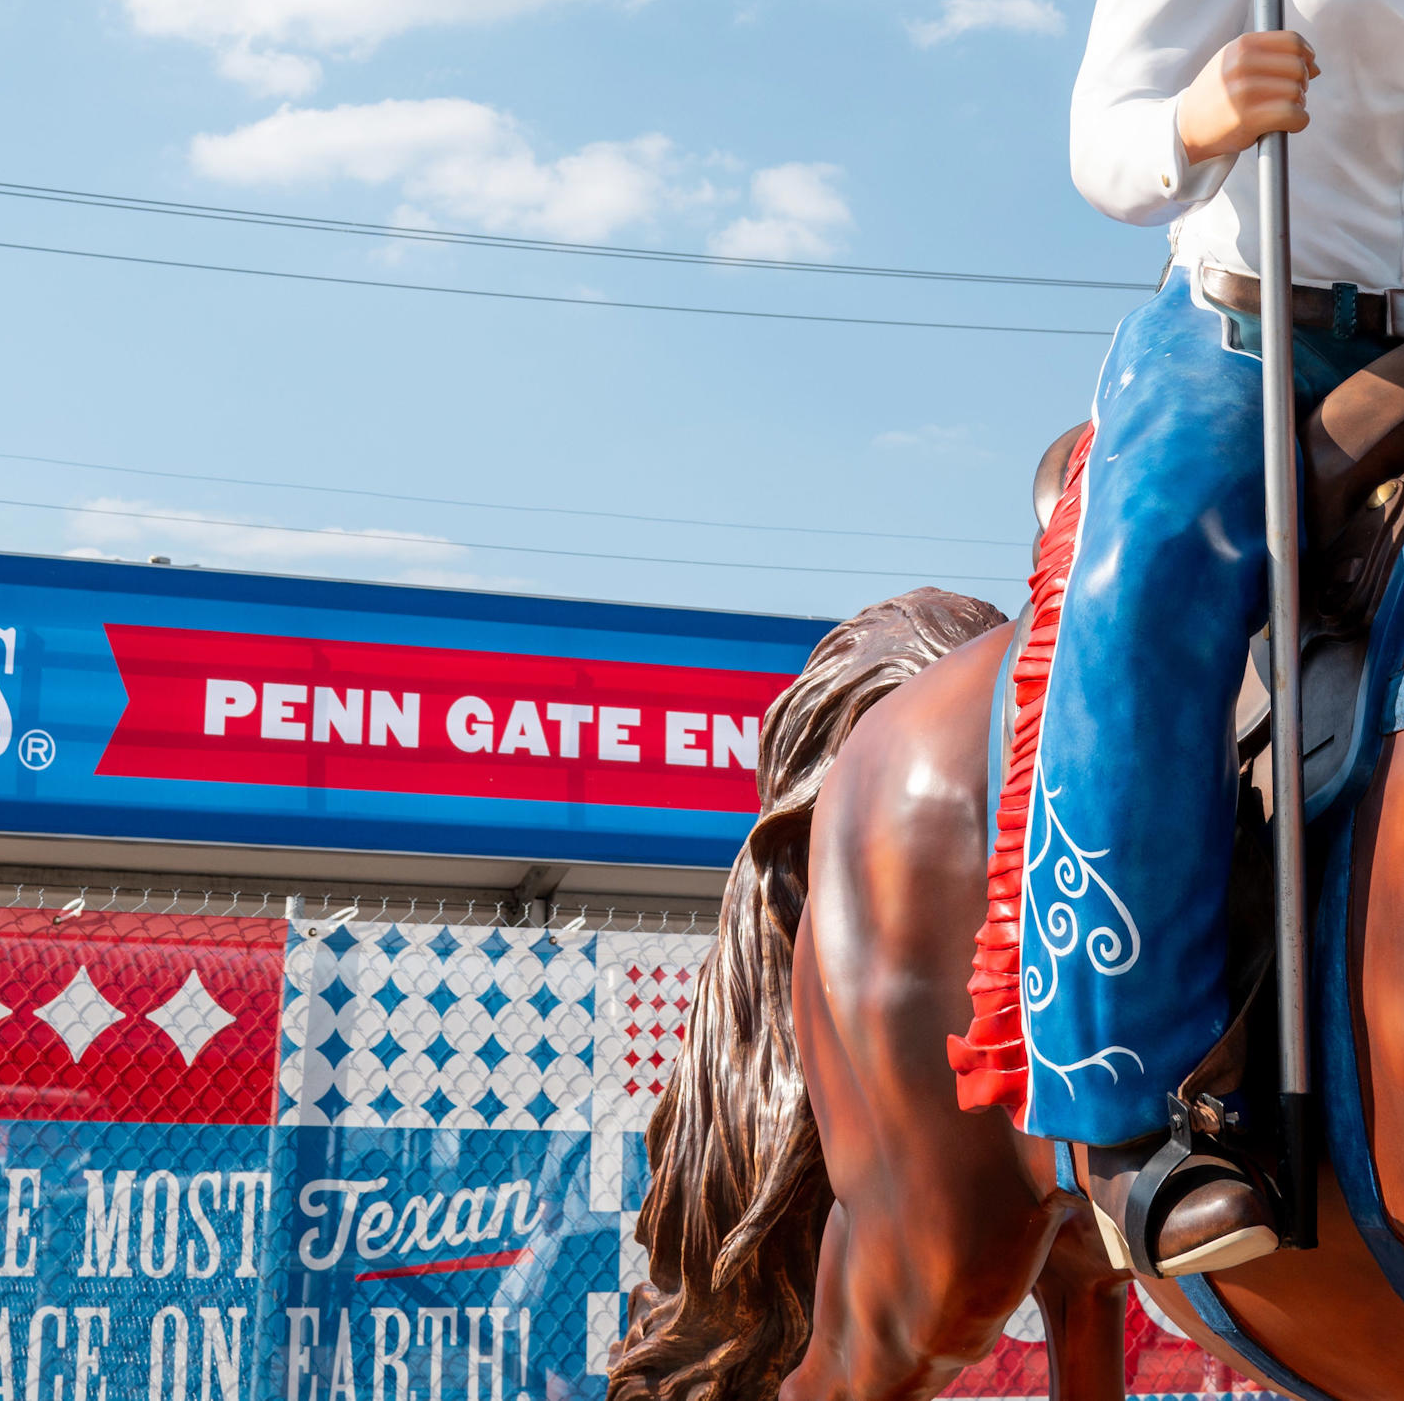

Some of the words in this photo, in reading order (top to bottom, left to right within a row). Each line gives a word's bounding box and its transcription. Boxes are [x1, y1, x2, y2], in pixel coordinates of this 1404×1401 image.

[204, 678, 420, 749] PENN
[446, 695, 641, 763] GATE
[664, 710, 759, 770] EN
[78, 1169, 271, 1280] MOST
[298, 1177, 546, 1271] Texan
[149, 1305, 248, 1401] ON
[286, 1307, 530, 1401] EARTH!
